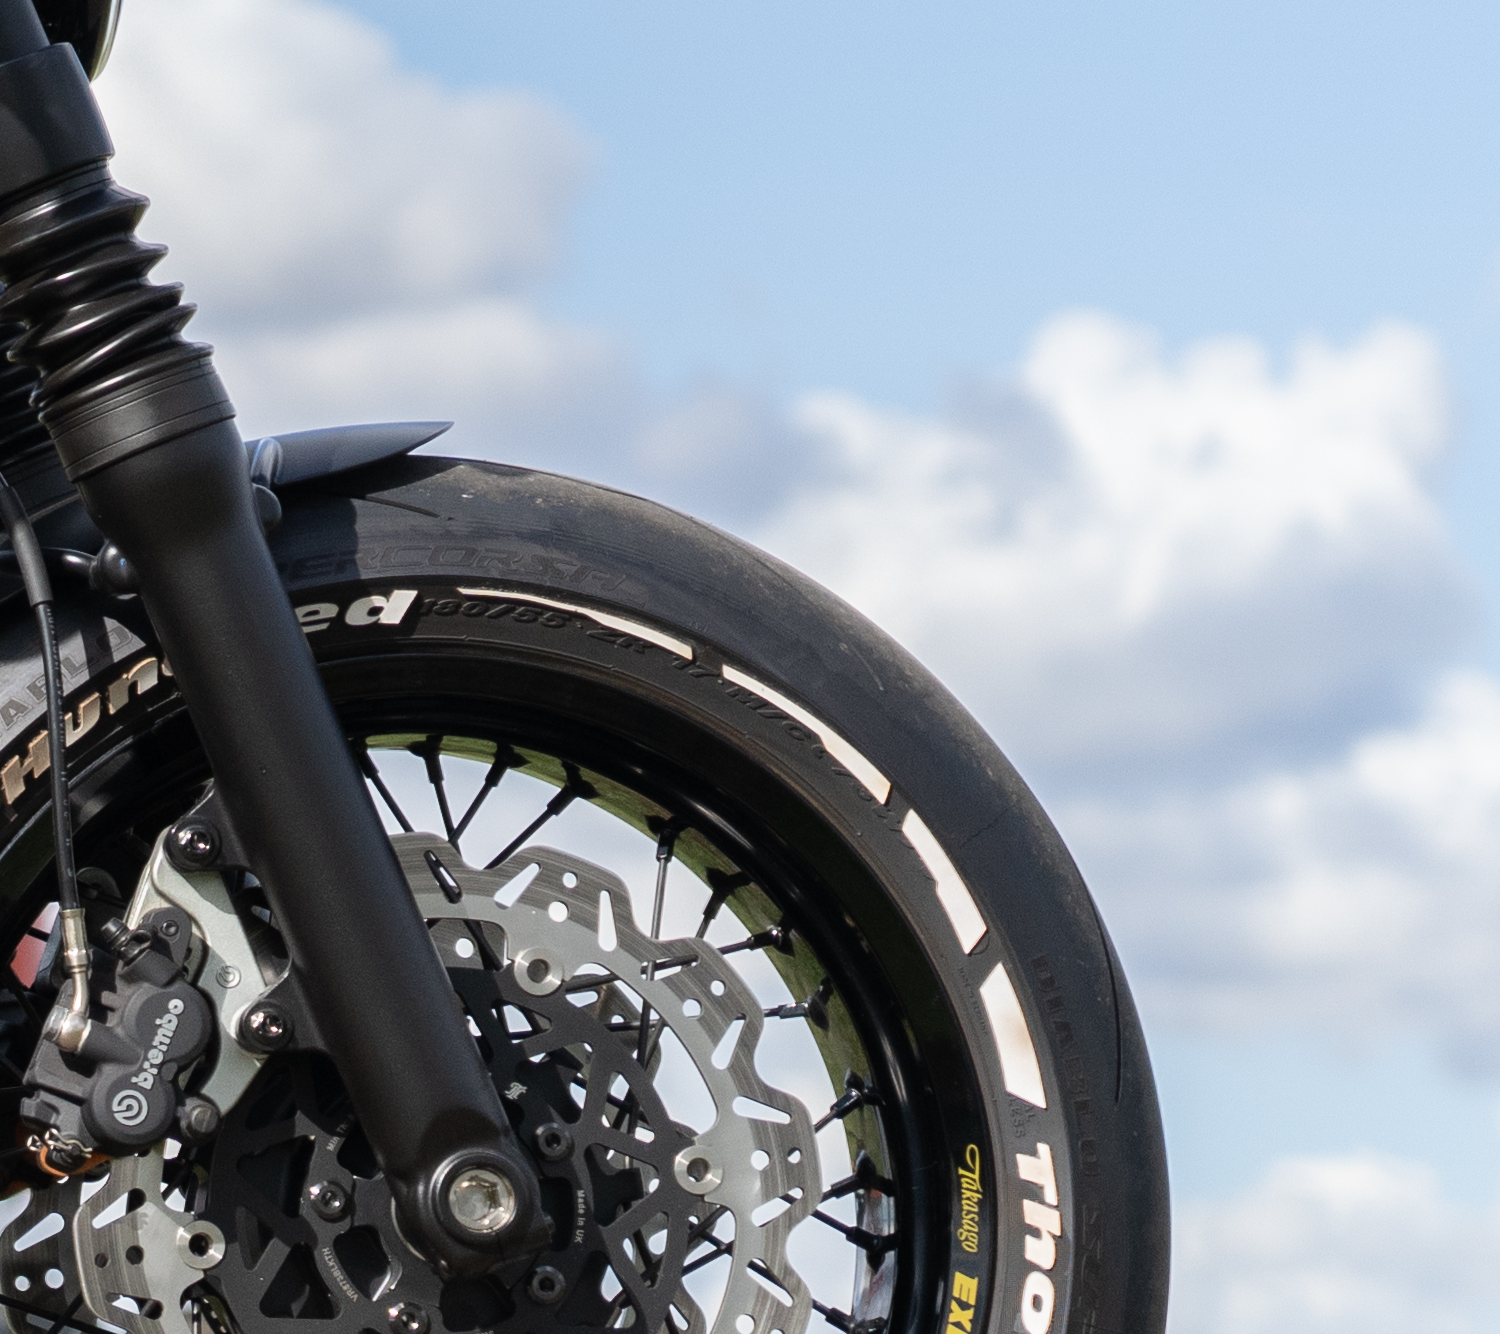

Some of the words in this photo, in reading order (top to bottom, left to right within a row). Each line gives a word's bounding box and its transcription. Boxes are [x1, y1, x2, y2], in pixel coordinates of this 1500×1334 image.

[131, 997, 185, 1092] brembo
[576, 1188, 587, 1212] Made
[953, 1143, 982, 1255] Takasago
[573, 1228, 585, 1245] UK
